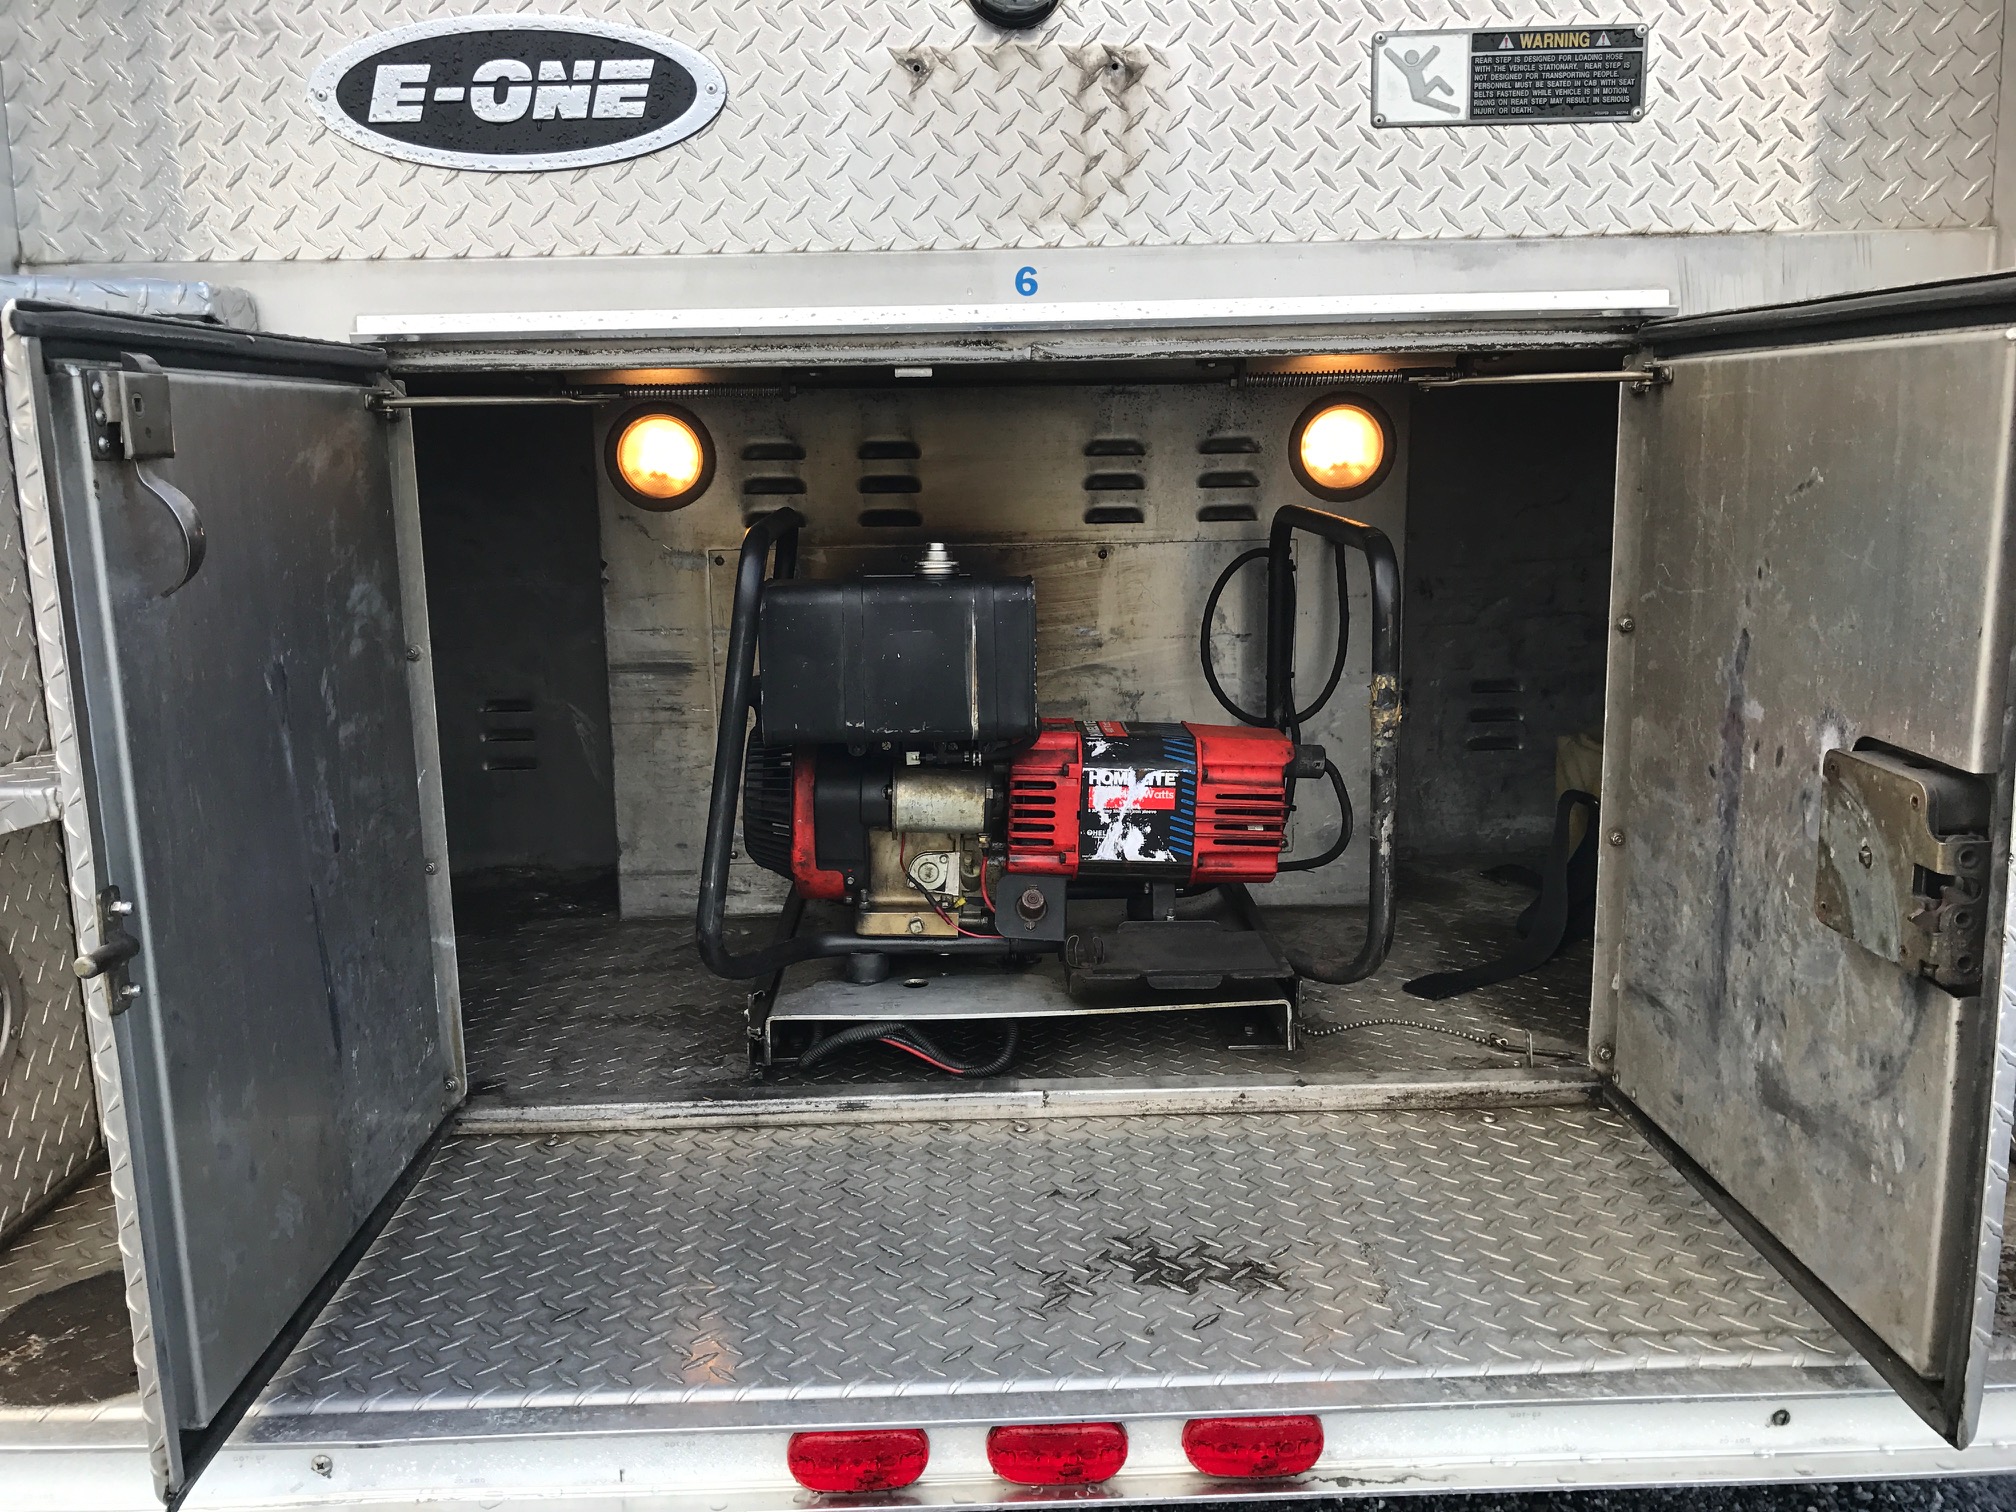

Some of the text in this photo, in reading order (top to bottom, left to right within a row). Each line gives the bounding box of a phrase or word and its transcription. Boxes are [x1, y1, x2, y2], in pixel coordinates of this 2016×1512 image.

[1520, 32, 1590, 49] WARNING
[1523, 55, 1556, 63] DESIGNED
[1474, 65, 1491, 73] WITH
[1509, 64, 1536, 72] VEHICLE
[1538, 63, 1579, 71] STATIONARY.
[1584, 62, 1602, 70] REAR
[1490, 73, 1523, 81] DESIGNED
[1525, 72, 1539, 80] FOR
[1542, 71, 1590, 79] TRANSPORTING
[1593, 70, 1619, 78] PEOPLE.
[1474, 82, 1512, 90] PERSONNEL
[1584, 79, 1597, 87] CAB
[369, 59, 654, 123] E-ONE
[1555, 88, 1581, 96] VEHICLE
[1566, 96, 1591, 104] RESULT
[1602, 95, 1630, 103] SERIOUS
[1473, 107, 1496, 115] INJURY
[1511, 106, 1534, 114] DEATH.
[1015, 266, 1038, 296] 6
